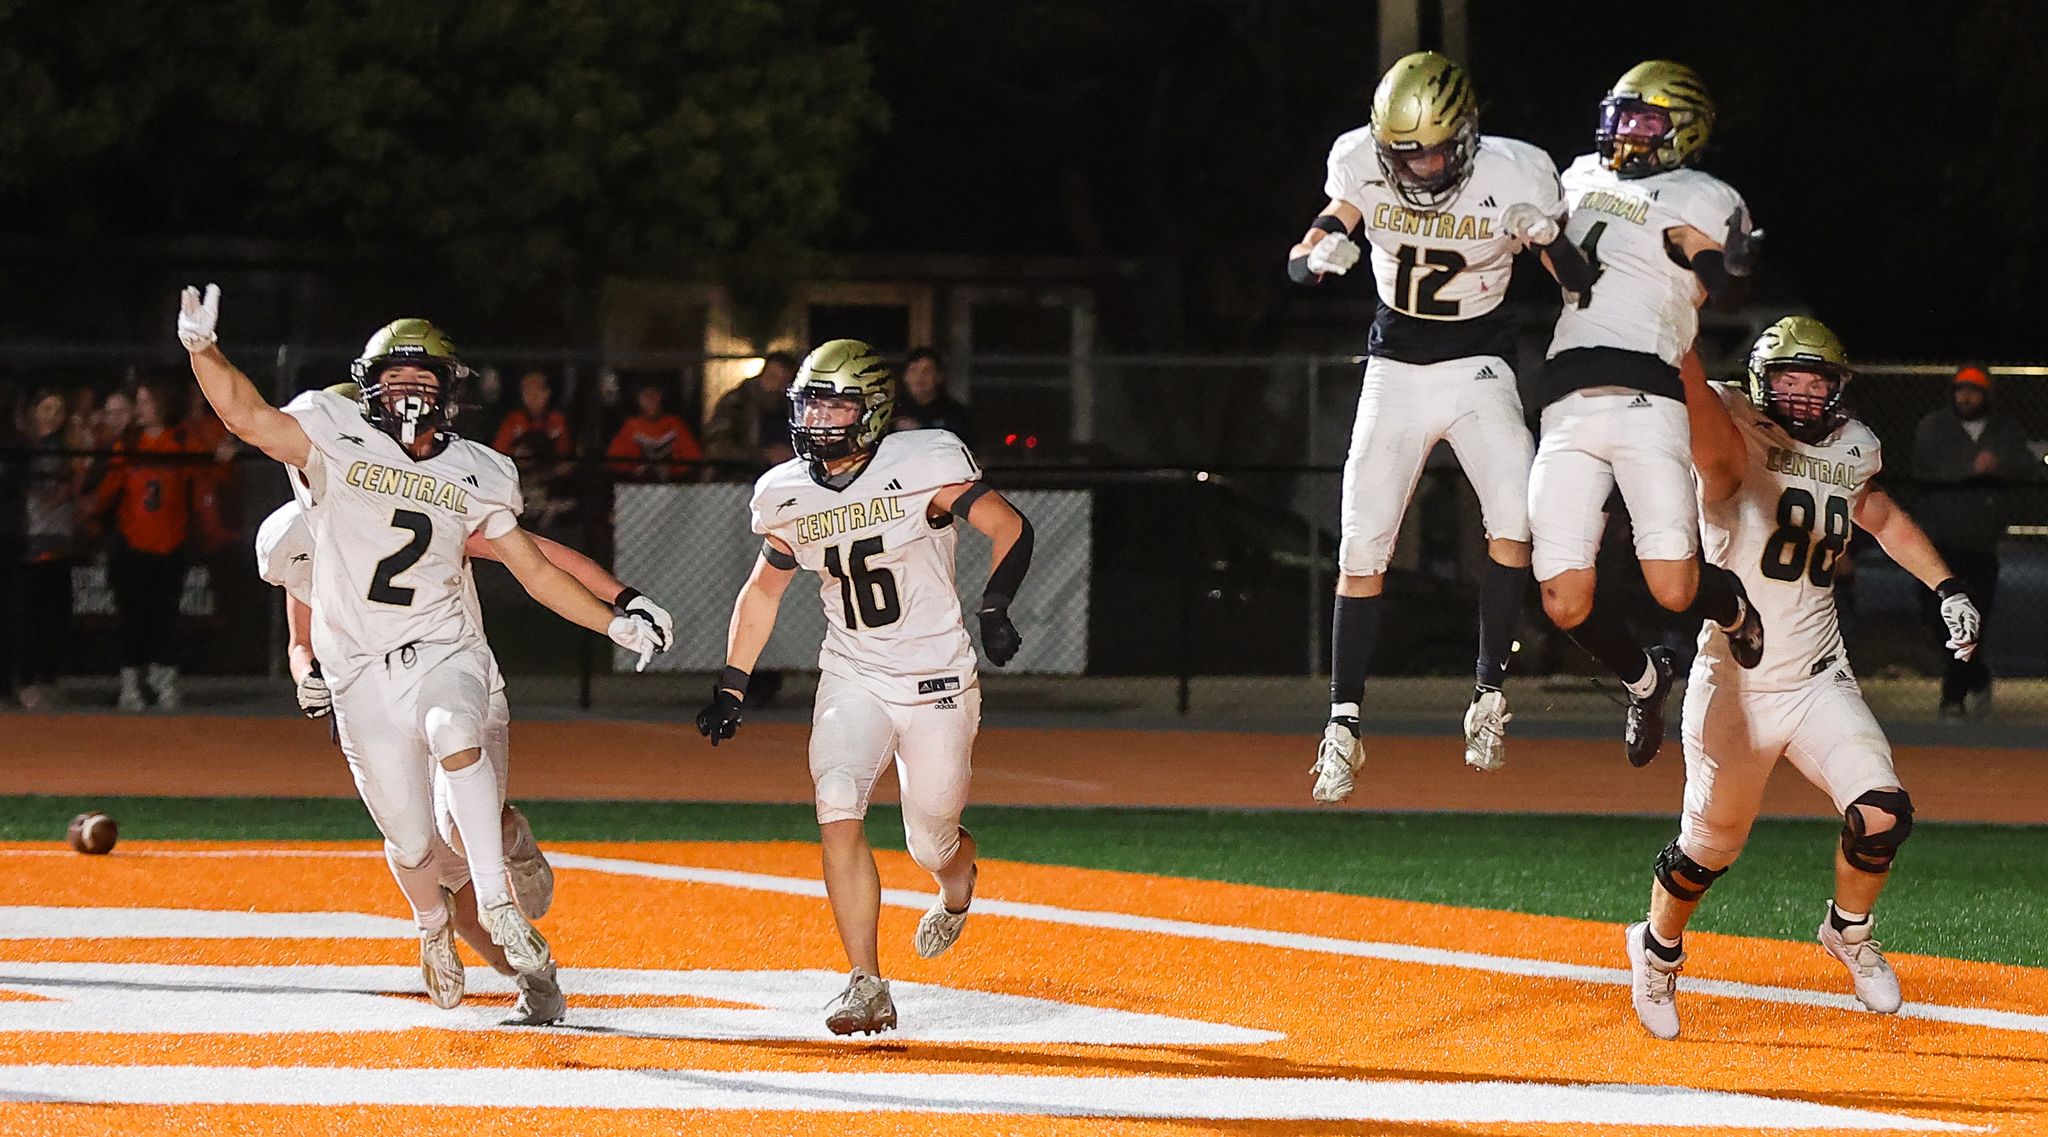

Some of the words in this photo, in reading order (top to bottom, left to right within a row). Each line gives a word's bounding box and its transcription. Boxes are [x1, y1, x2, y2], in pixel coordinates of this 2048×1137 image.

[1373, 202, 1494, 240] CENTRAL
[1394, 243, 1467, 316] 12
[346, 460, 468, 514] CENTRAL
[1766, 446, 1859, 491] CENTRAL
[796, 496, 905, 544] CENTRAL
[1760, 486, 1850, 588] 88
[367, 507, 433, 607] 2
[823, 534, 901, 631] 16
